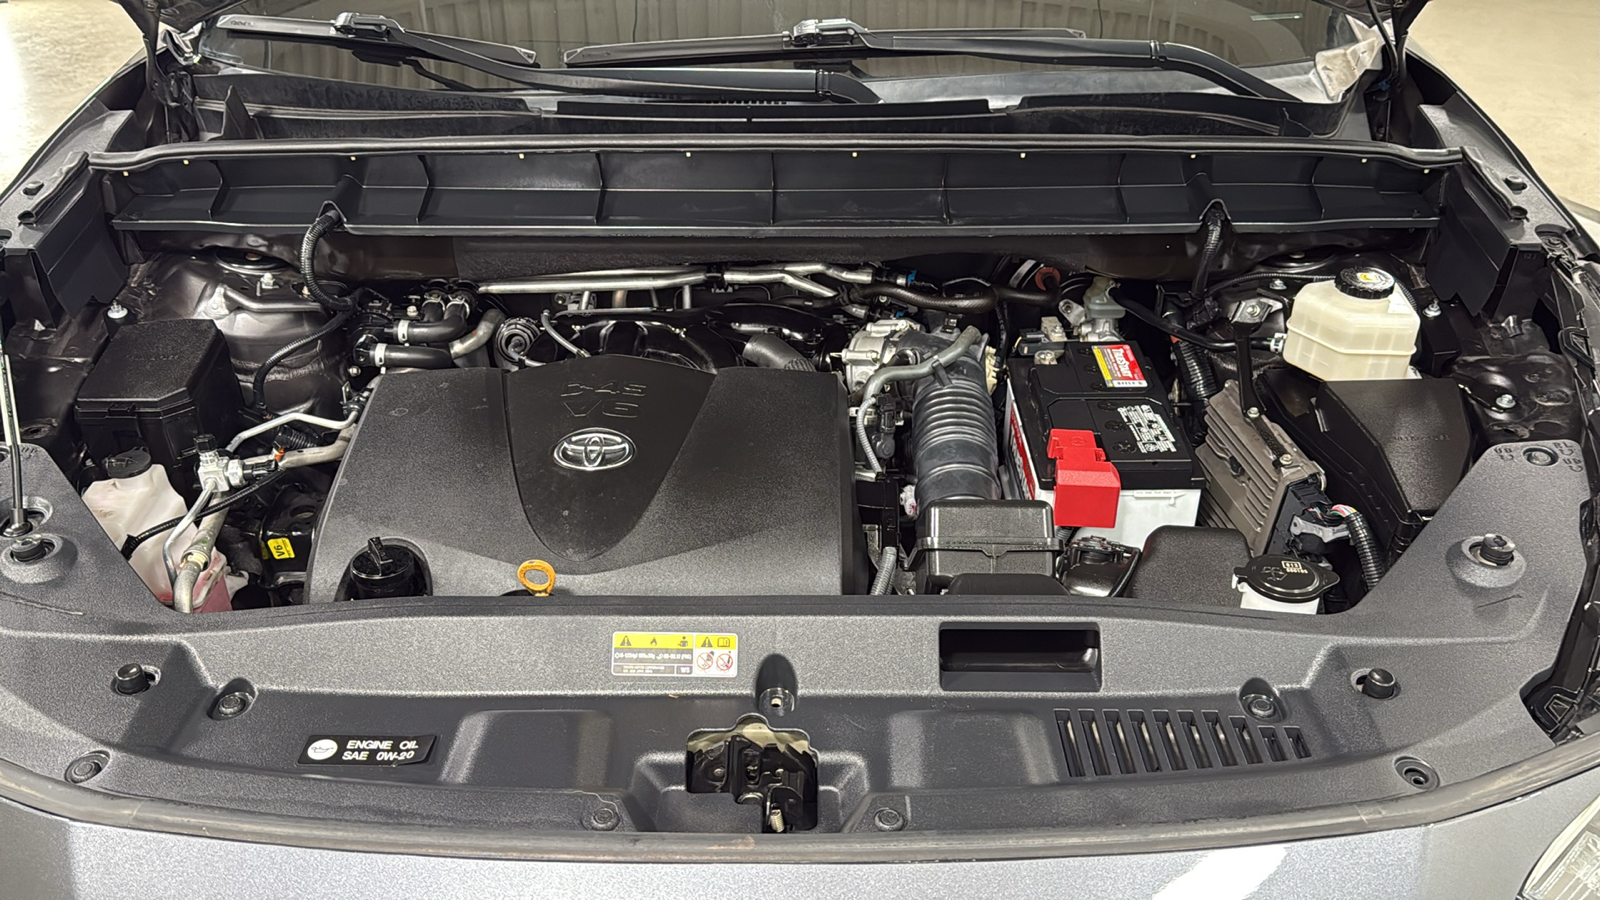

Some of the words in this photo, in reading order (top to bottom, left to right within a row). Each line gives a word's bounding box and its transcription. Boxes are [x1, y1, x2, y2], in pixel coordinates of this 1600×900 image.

[562, 399, 639, 418] V6
[273, 545, 285, 557] V6
[346, 740, 393, 750] ENGINE
[399, 740, 419, 750] OIL
[341, 751, 369, 760] SAE
